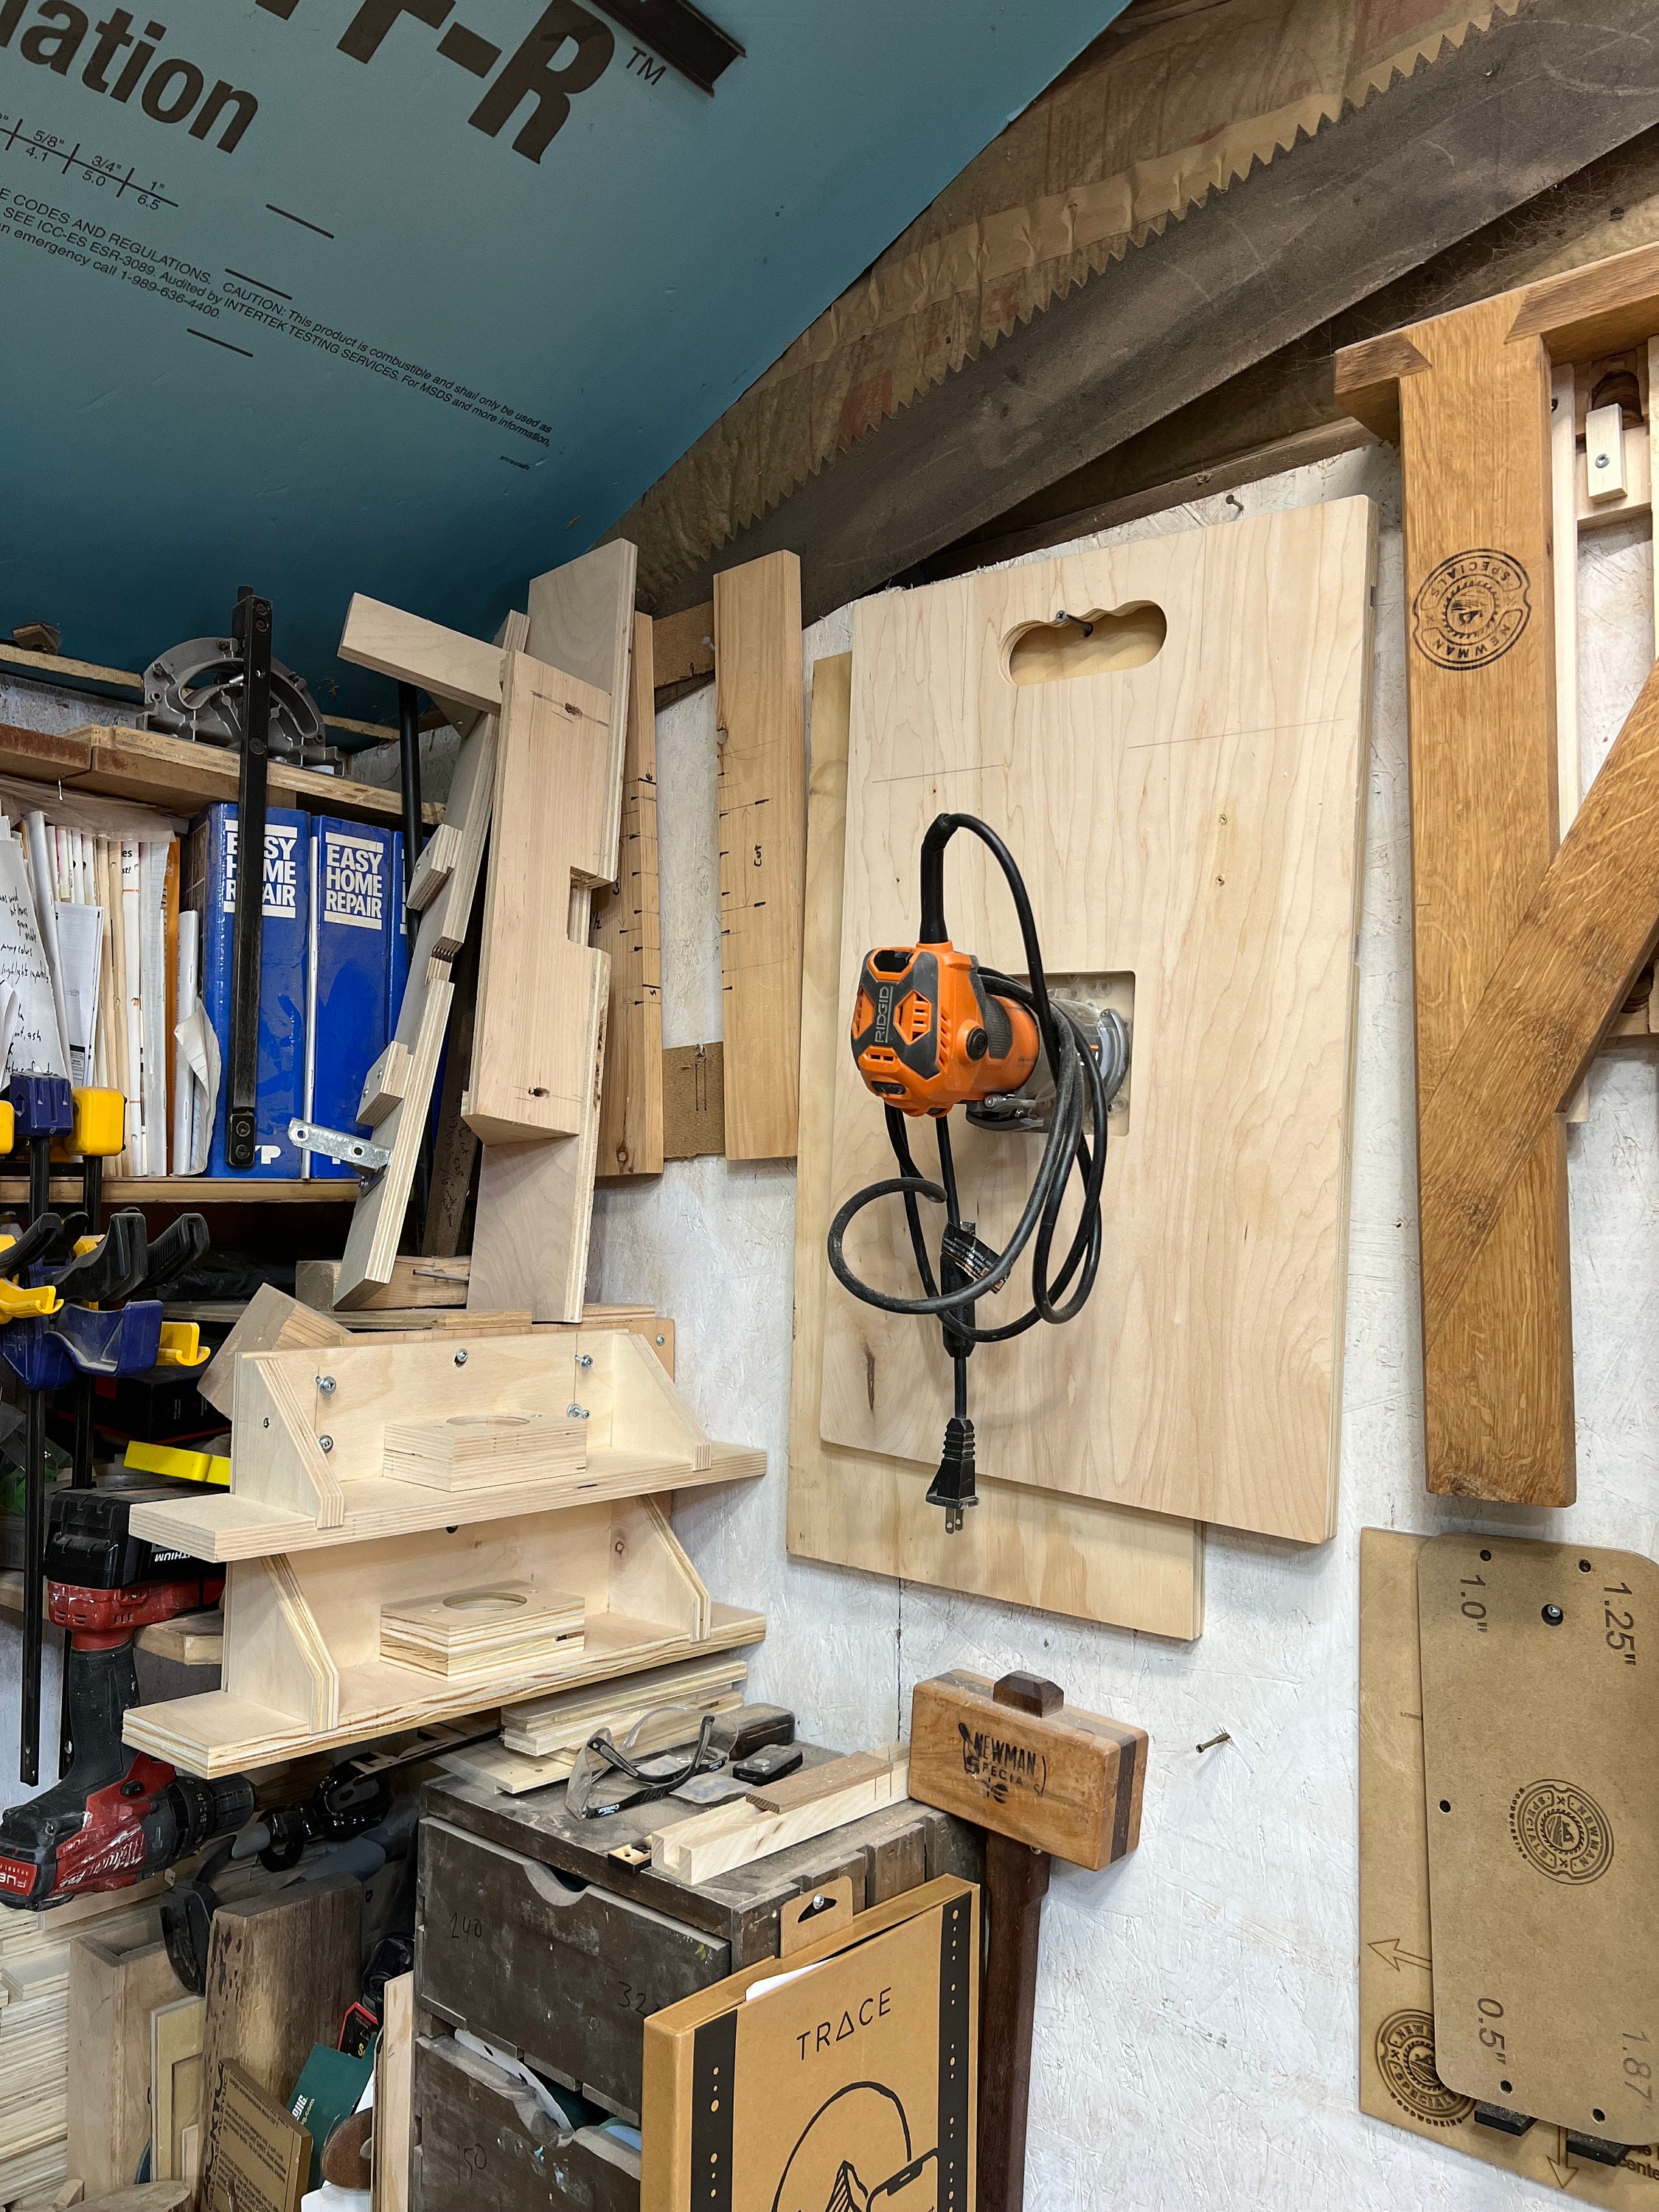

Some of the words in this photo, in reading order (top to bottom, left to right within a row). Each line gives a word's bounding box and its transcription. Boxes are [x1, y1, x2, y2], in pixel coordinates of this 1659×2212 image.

[33, 130, 65, 147] 5/8"
[25, 147, 49, 162] 4.1
[91, 156, 122, 173] 3/4"
[82, 170, 106, 187] 5.0
[137, 194, 161, 210] 6.5
[14, 230, 90, 265] emergency
[93, 260, 116, 276] call
[121, 271, 220, 319] 1-989-636-4400.
[4, 207, 35, 226] SEE
[37, 220, 88, 247] ICC-ES
[89, 242, 156, 276] ESR-3089.
[160, 271, 206, 297] Audited
[207, 291, 223, 305] by
[223, 298, 288, 332] INTERTEK
[288, 325, 340, 353] TESTING
[341, 349, 399, 380] SERVICES.
[401, 375, 420, 389] For
[420, 383, 452, 402] MSDS
[452, 398, 473, 412] and
[472, 408, 498, 423] more
[498, 416, 551, 447] information,
[13, 195, 70, 223] CODES
[72, 219, 105, 238] AND
[110, 233, 211, 285] REGULATIONS.
[223, 282, 287, 320] CAUTION:
[288, 310, 312, 327] This
[313, 321, 358, 349] product
[358, 341, 368, 352] is
[369, 347, 431, 380] combustible
[433, 375, 454, 390] and
[454, 383, 479, 400] shall
[479, 394, 501, 411] only
[501, 405, 514, 417] be
[515, 411, 540, 428] used
[540, 423, 552, 433] as
[1430, 561, 1510, 598] SPECIALS
[1433, 625, 1511, 659] NEWMAN
[227, 833, 296, 859] ESY
[327, 844, 383, 875] EASY
[227, 855, 296, 885] HME
[327, 868, 383, 897] HOME
[226, 880, 295, 906] RAIR
[326, 892, 382, 919] REPAIR
[874, 986, 890, 1044] RIDGID
[154, 1551, 191, 1562] THIUM
[1459, 1574, 1488, 1633] 1.0"
[1603, 1582, 1637, 1666] 1.25"
[974, 1731, 1037, 1775] NEWMAN
[796, 1986, 892, 2061] TRACE
[1477, 1997, 1506, 2065] 0.5"
